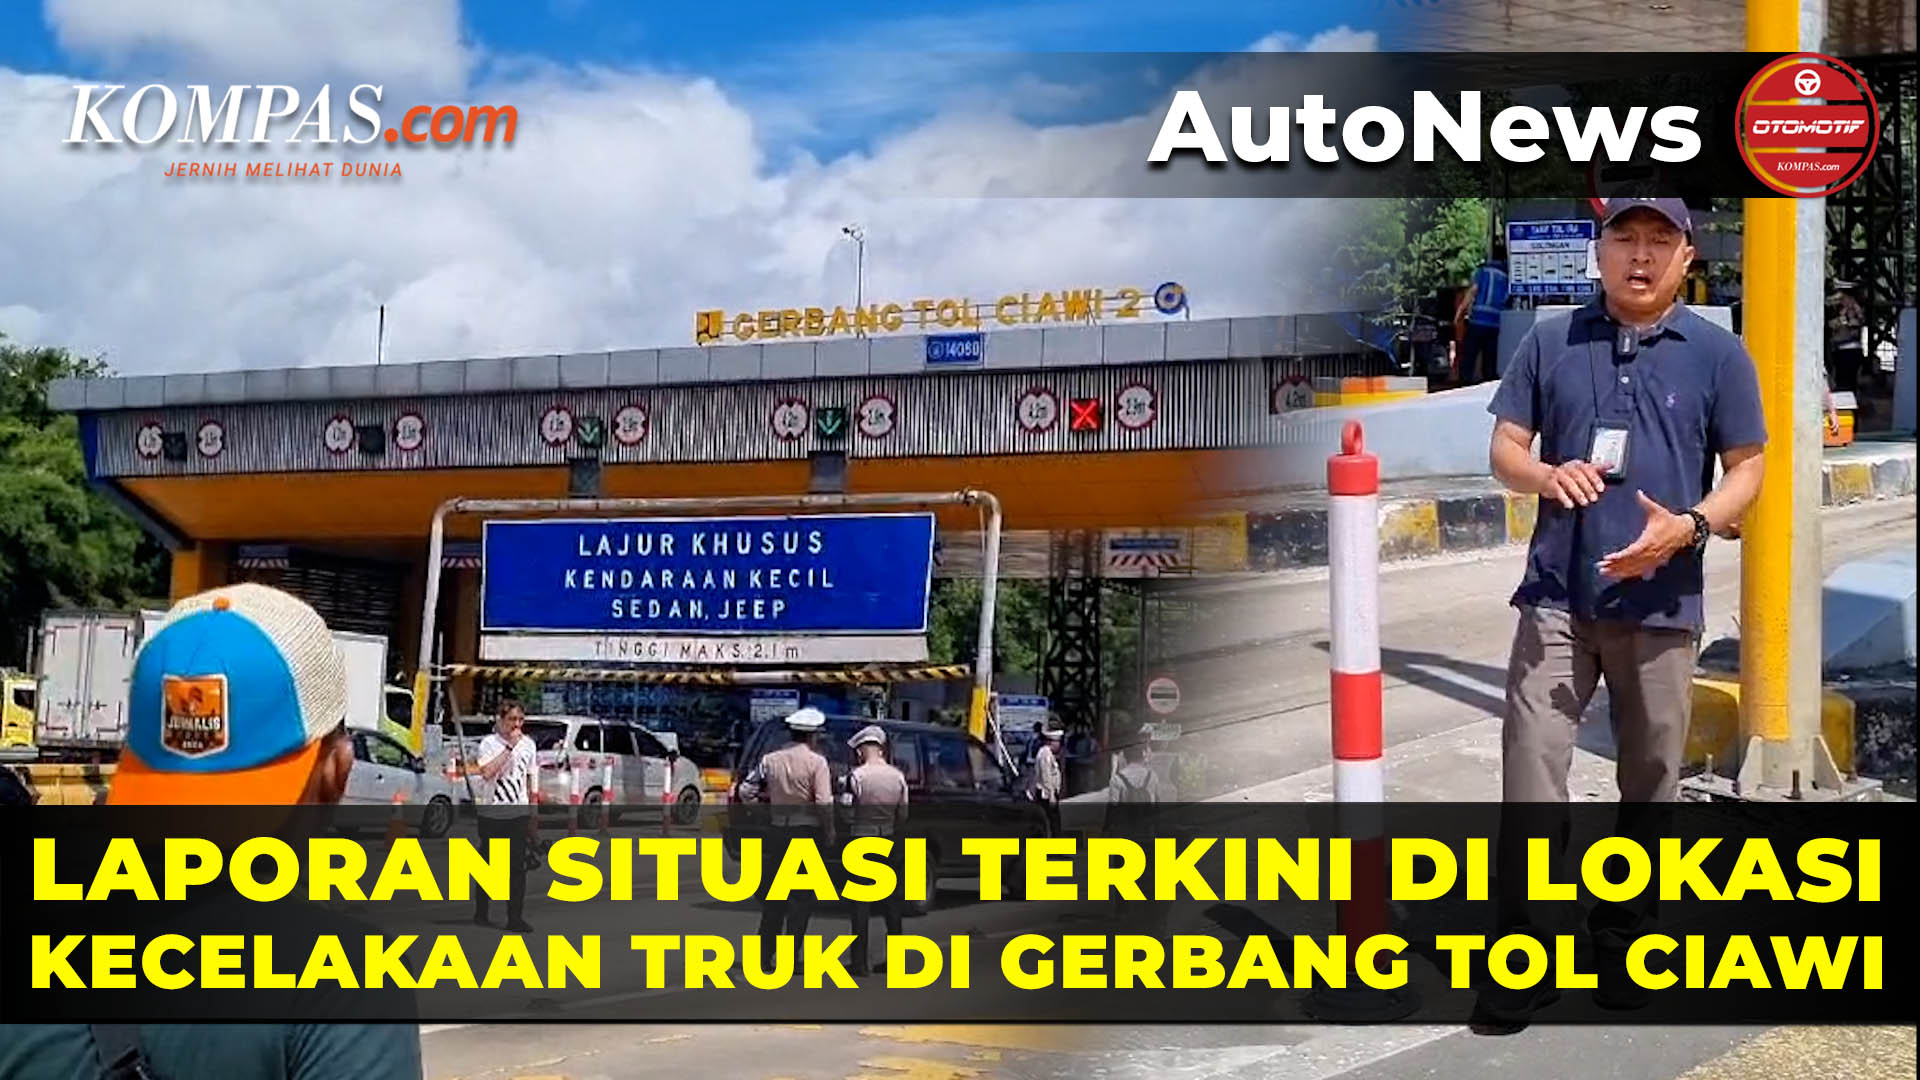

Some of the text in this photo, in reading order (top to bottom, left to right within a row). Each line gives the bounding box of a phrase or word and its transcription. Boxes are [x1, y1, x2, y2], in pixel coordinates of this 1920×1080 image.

[732, 286, 1141, 341] GERBANG TOL CIAWI 2
[579, 531, 823, 557] LAJUR KHUSUS
[565, 568, 834, 589] KENDARAAN KECIL
[611, 598, 787, 620] SEDAN, JEEP
[596, 640, 669, 658] TINGGI
